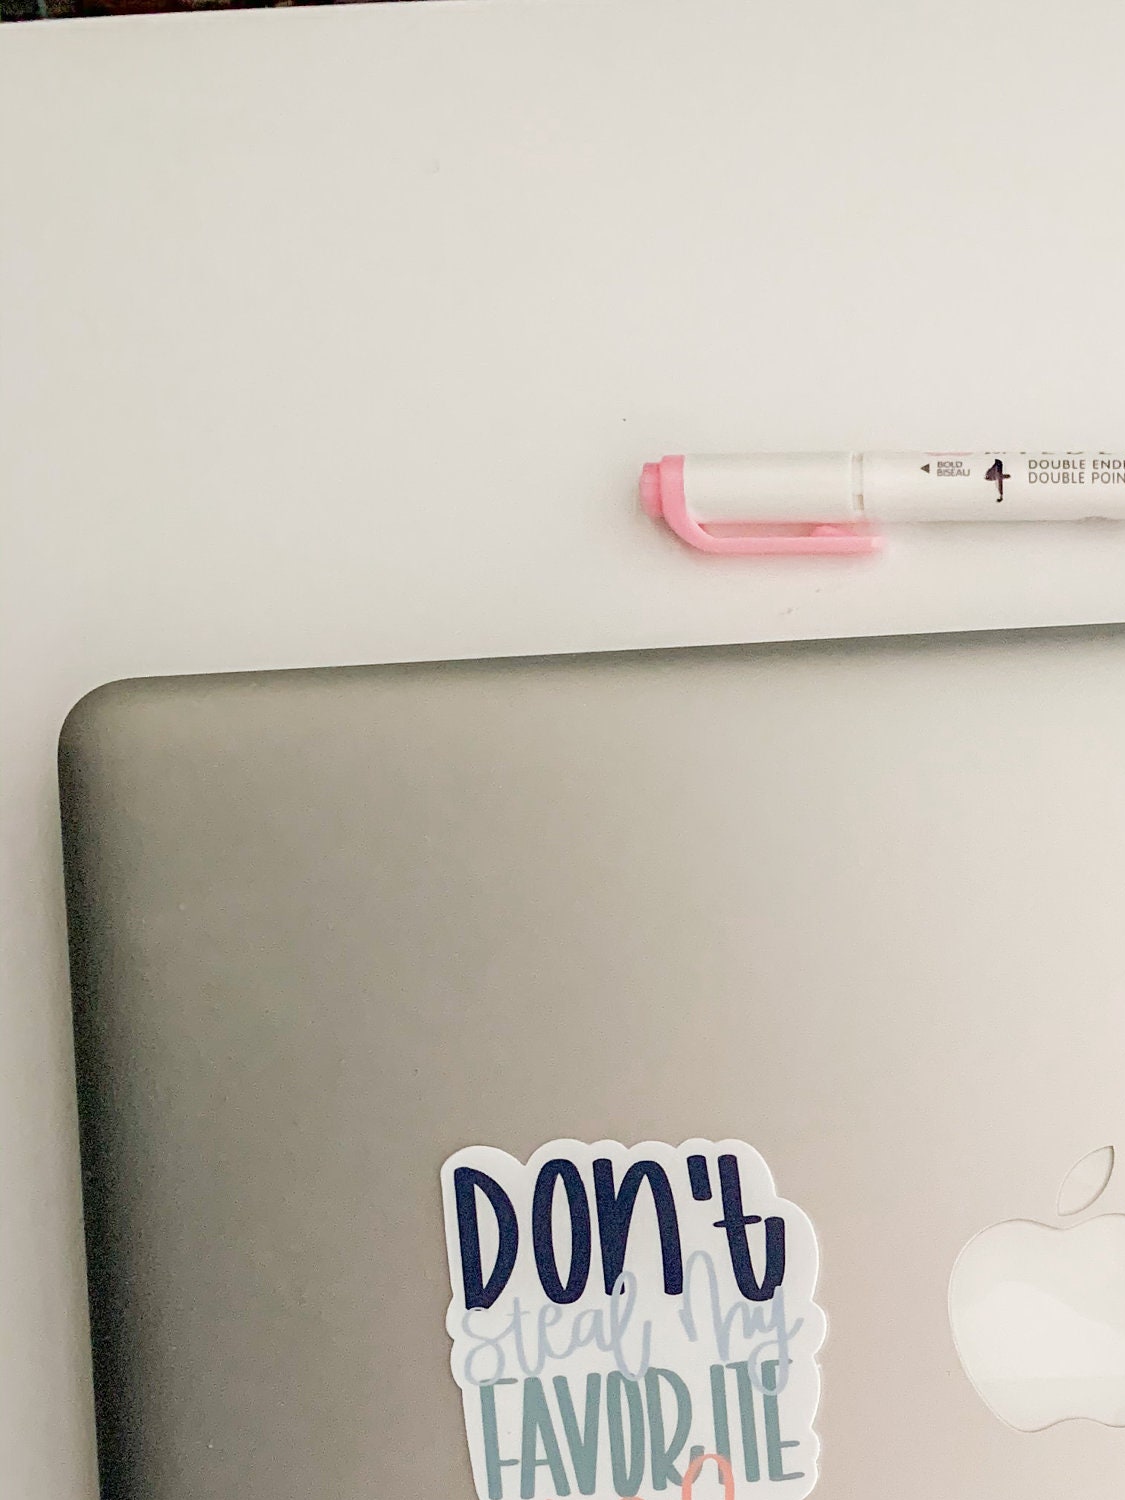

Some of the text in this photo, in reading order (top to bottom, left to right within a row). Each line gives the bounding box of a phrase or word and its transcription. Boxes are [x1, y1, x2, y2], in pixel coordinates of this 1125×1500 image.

[1028, 459, 1086, 470] DOUBLE
[936, 468, 971, 477] BISEAU
[1028, 471, 1085, 484] DOUBLE
[479, 1359, 806, 1500] FAVORITE
